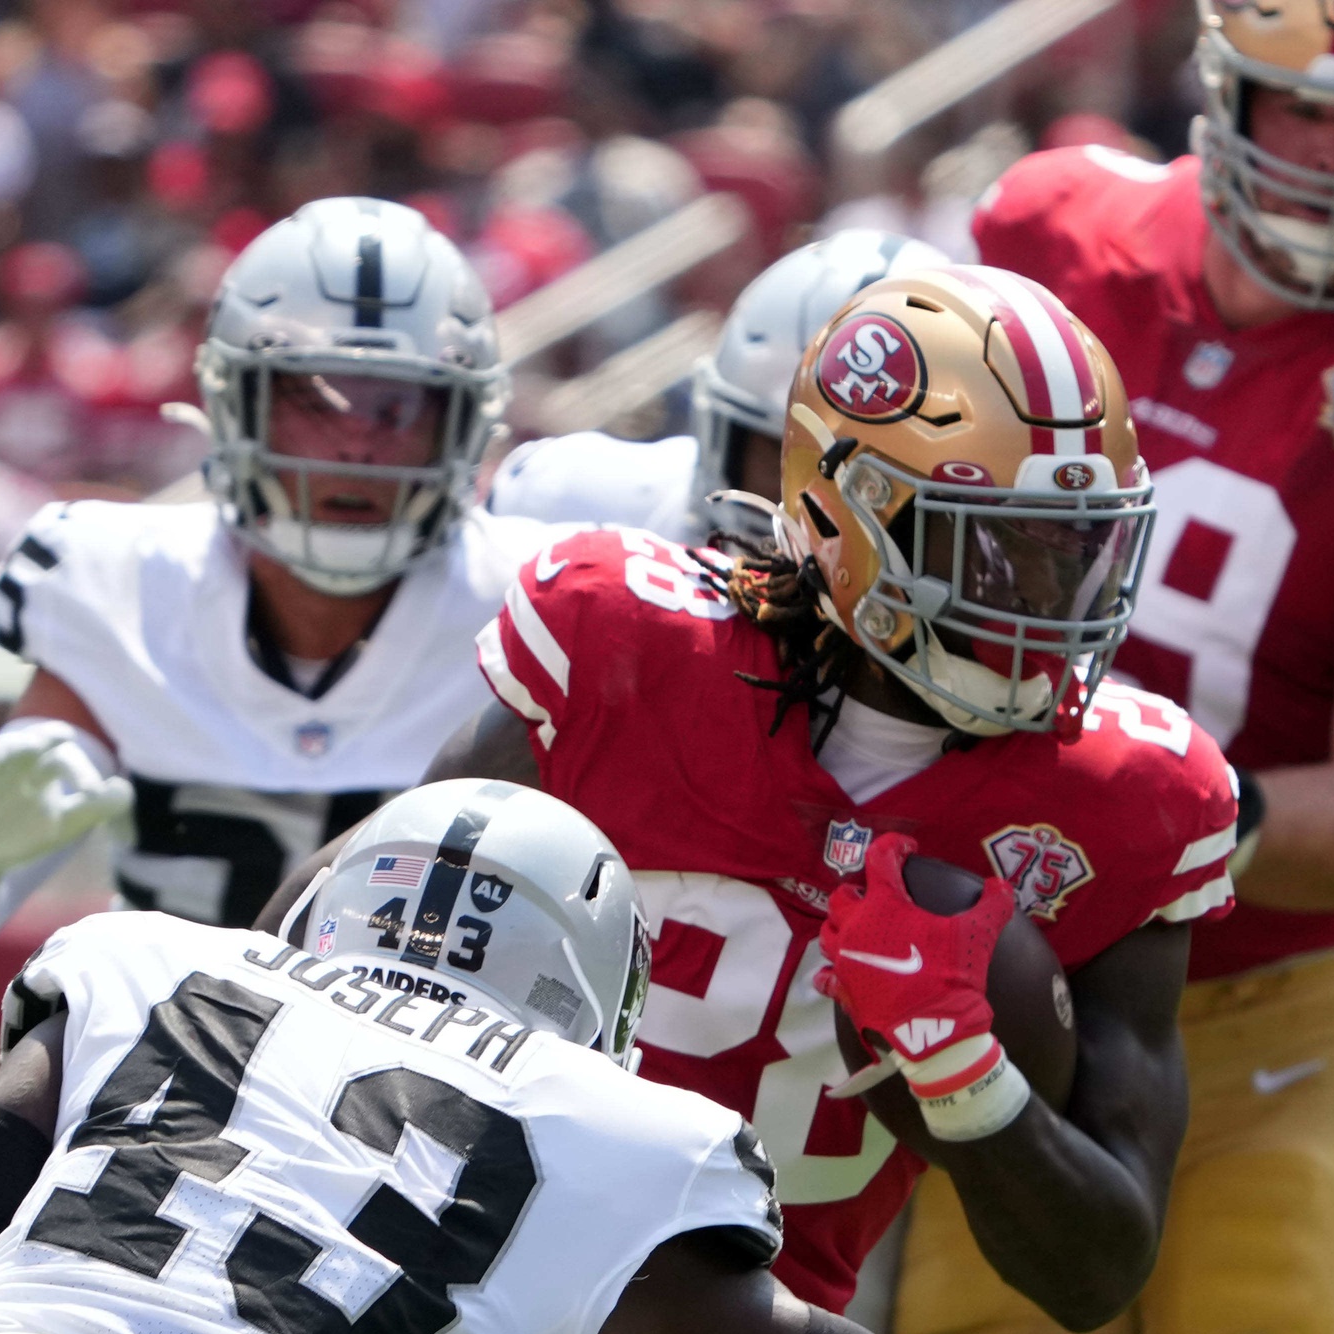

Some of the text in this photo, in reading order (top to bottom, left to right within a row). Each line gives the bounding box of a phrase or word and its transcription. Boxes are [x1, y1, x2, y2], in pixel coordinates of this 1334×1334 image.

[1081, 682, 1192, 758] 2
[116, 776, 383, 930] 5
[831, 840, 859, 866] NFL
[1007, 841, 1065, 897] 75
[472, 879, 504, 904] AL
[242, 943, 539, 1075] JOSEPH
